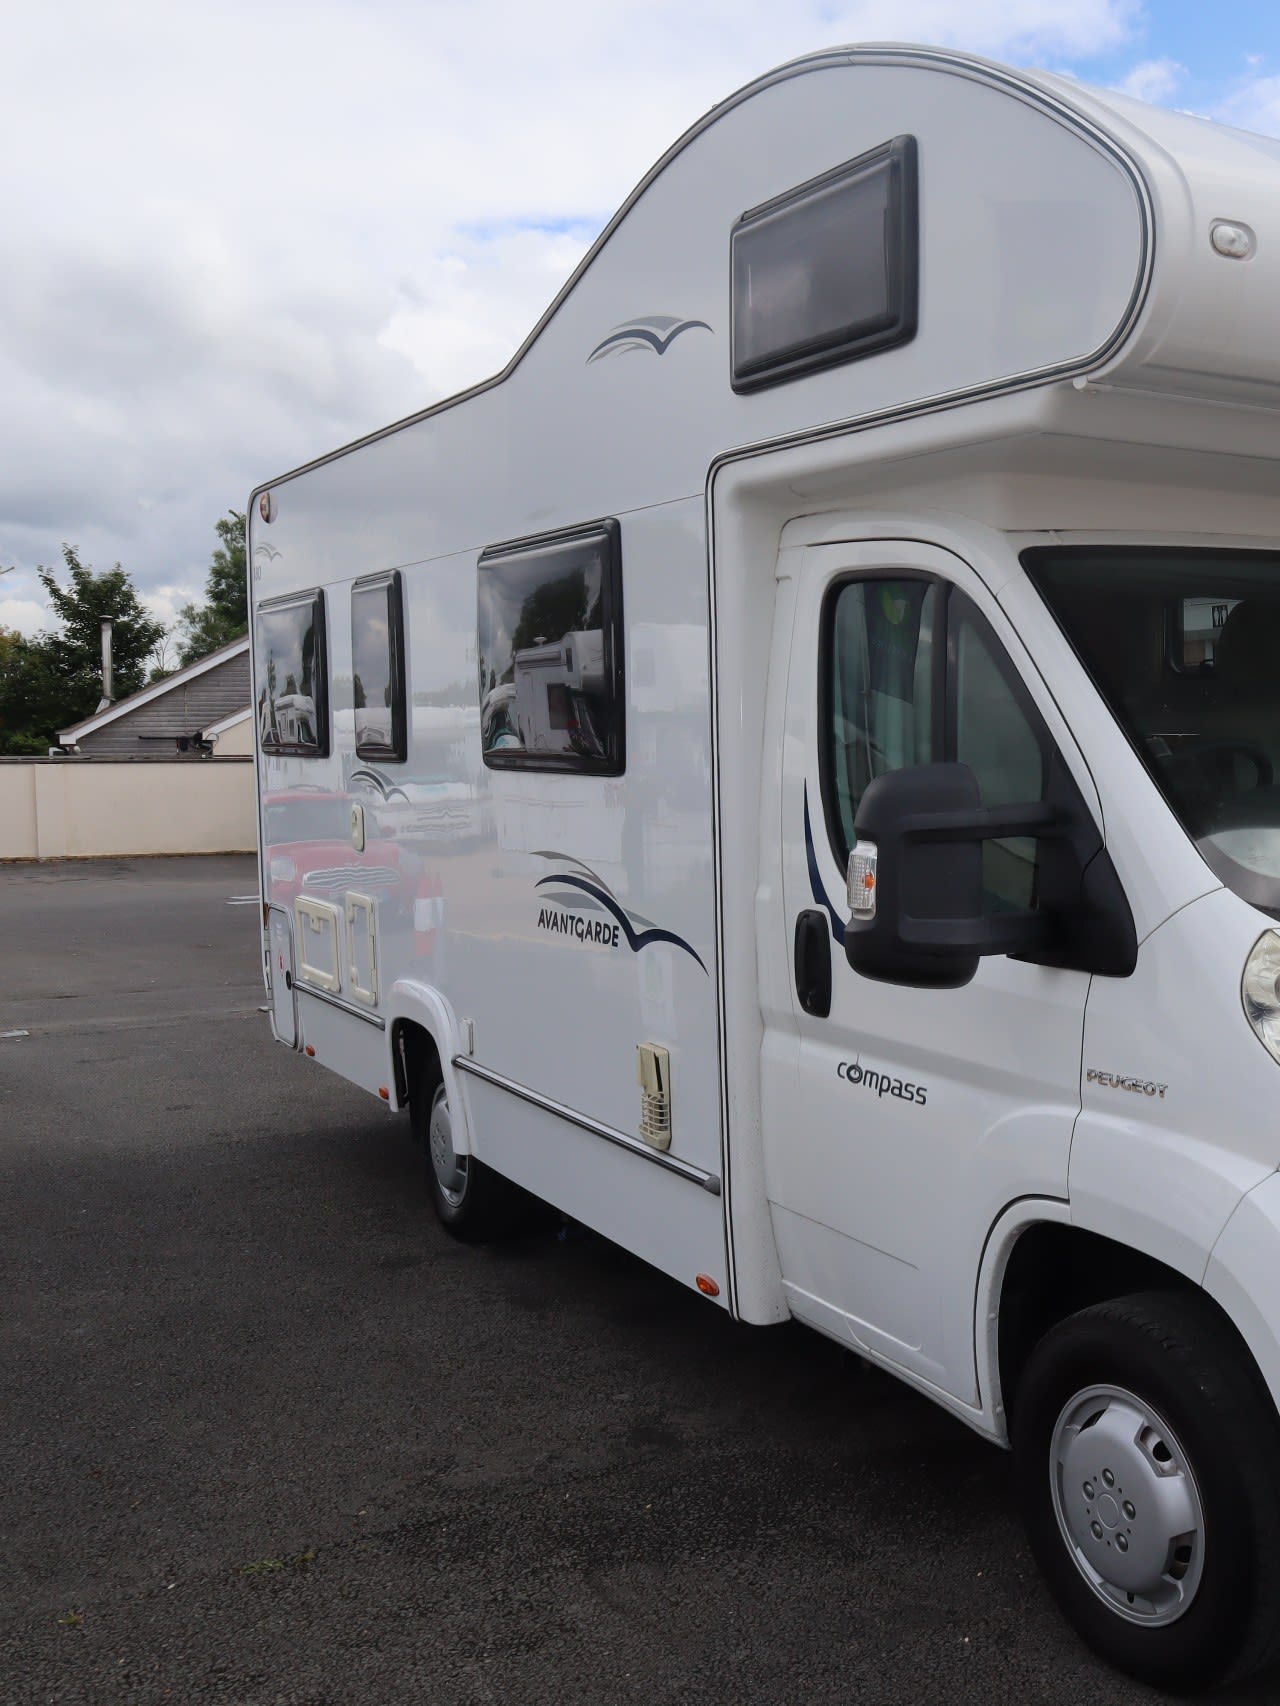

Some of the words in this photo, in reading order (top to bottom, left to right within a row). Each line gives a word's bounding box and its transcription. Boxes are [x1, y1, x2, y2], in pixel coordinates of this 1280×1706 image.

[538, 908, 620, 947] AVANTGARDE
[837, 1057, 928, 1106] compass
[1086, 1068, 1169, 1098] PEUGEOT
